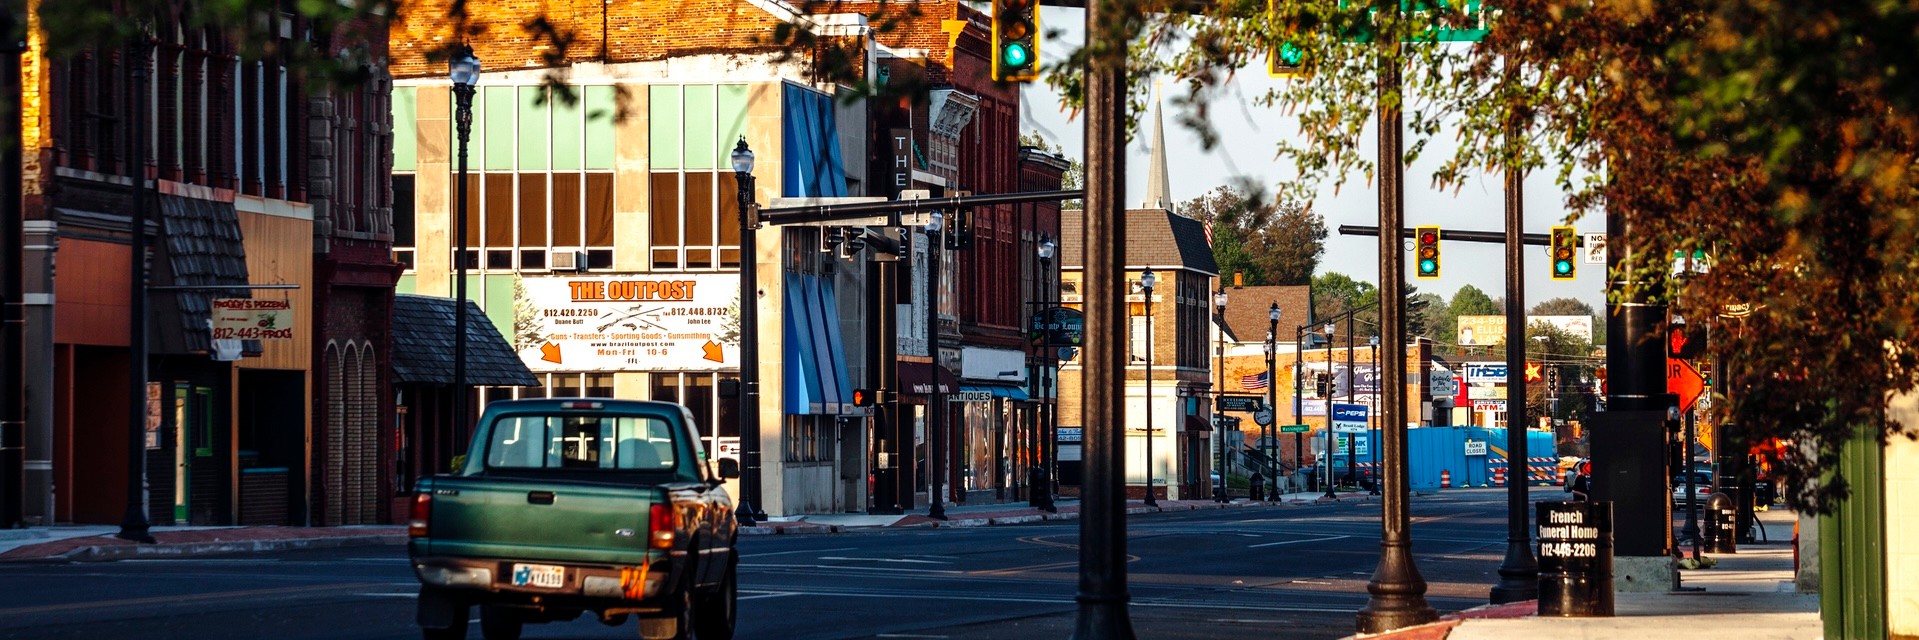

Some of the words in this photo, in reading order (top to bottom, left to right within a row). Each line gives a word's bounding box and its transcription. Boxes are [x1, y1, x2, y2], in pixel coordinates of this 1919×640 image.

[568, 281, 605, 300] THE
[608, 280, 696, 300] OUTPOST
[543, 308, 599, 317] 812.420.2250
[671, 307, 728, 316] 812.448.8732
[1461, 317, 1505, 325] 234-90
[213, 327, 292, 339] 812-443-FROG
[1477, 325, 1504, 335] ELLIS
[611, 333, 640, 341] Sporting
[667, 333, 711, 341] Gunsmithing
[948, 391, 991, 401] ANTIQUES
[1550, 510, 1583, 524] French
[1539, 525, 1570, 539] Funeral
[1571, 525, 1599, 539] Home
